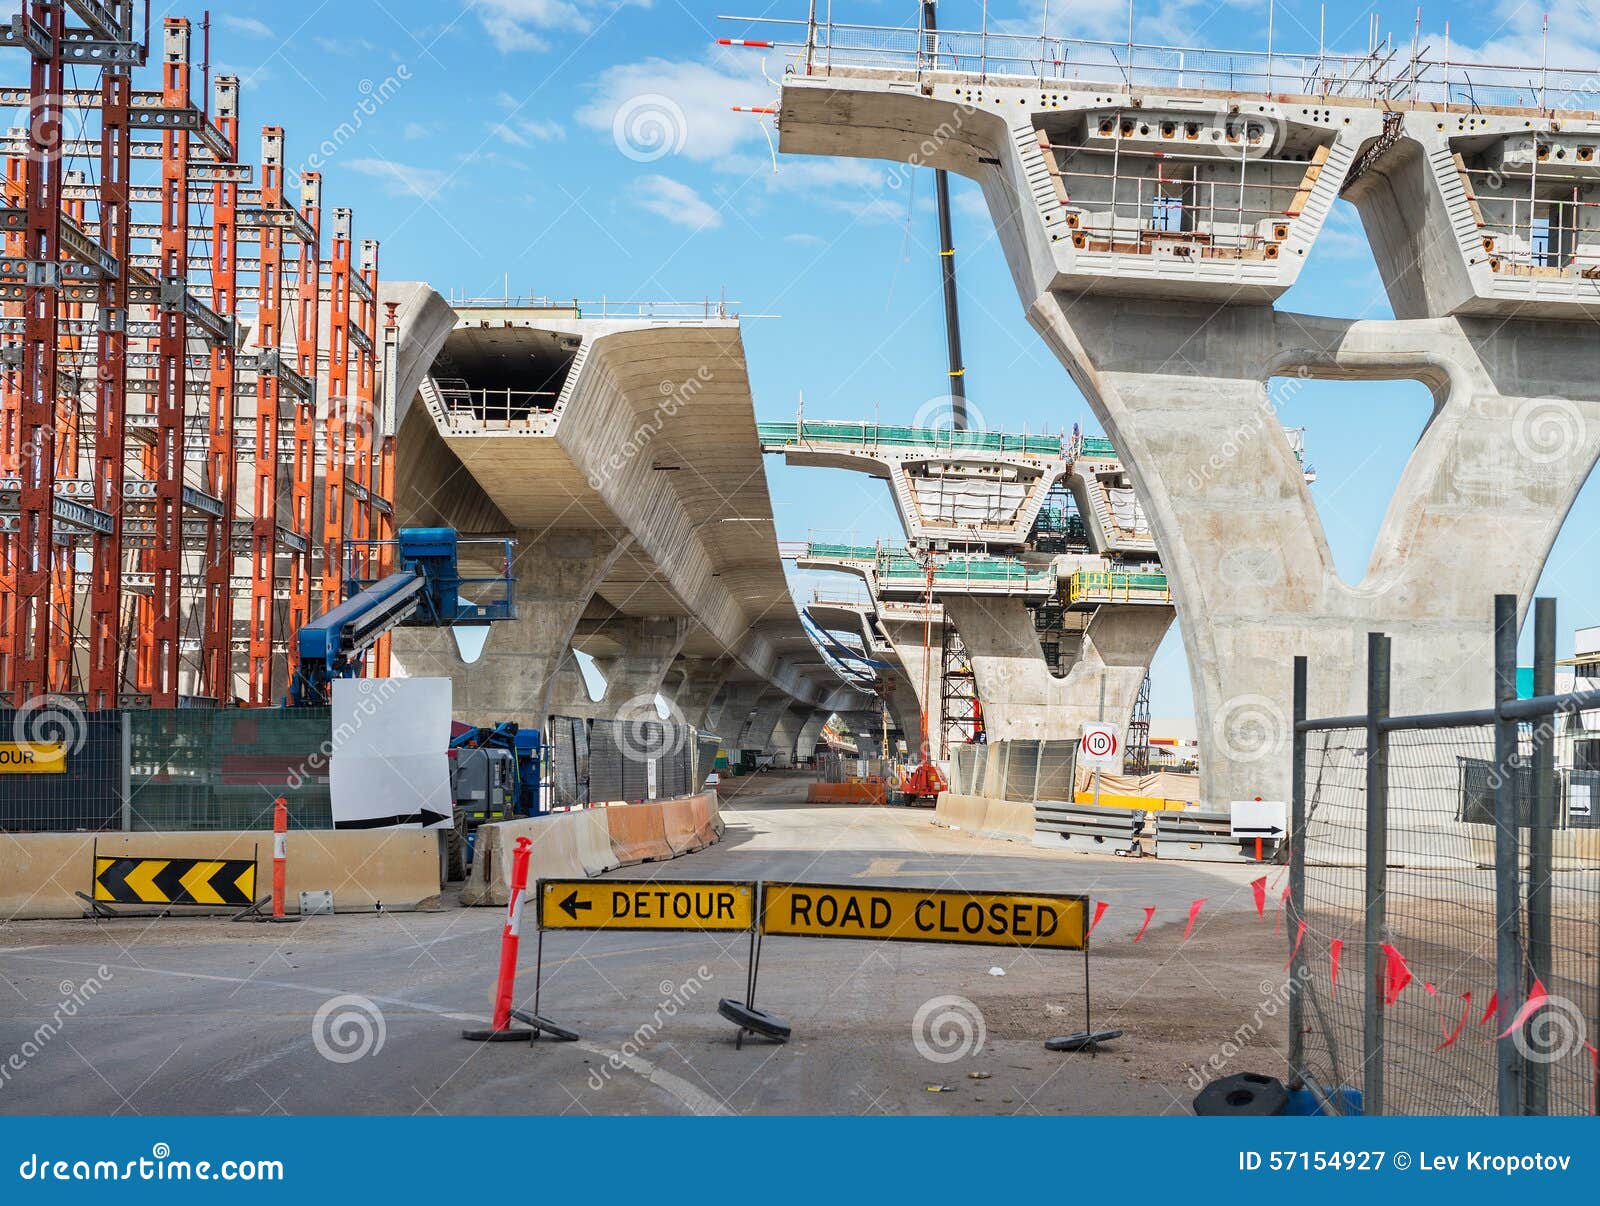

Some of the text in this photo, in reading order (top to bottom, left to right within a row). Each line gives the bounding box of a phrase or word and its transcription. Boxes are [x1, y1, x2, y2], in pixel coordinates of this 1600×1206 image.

[1094, 738, 1105, 749] 10
[0, 751, 34, 764] OUR
[612, 891, 735, 919] DETOUR
[790, 893, 1058, 937] ROAD CLOSED
